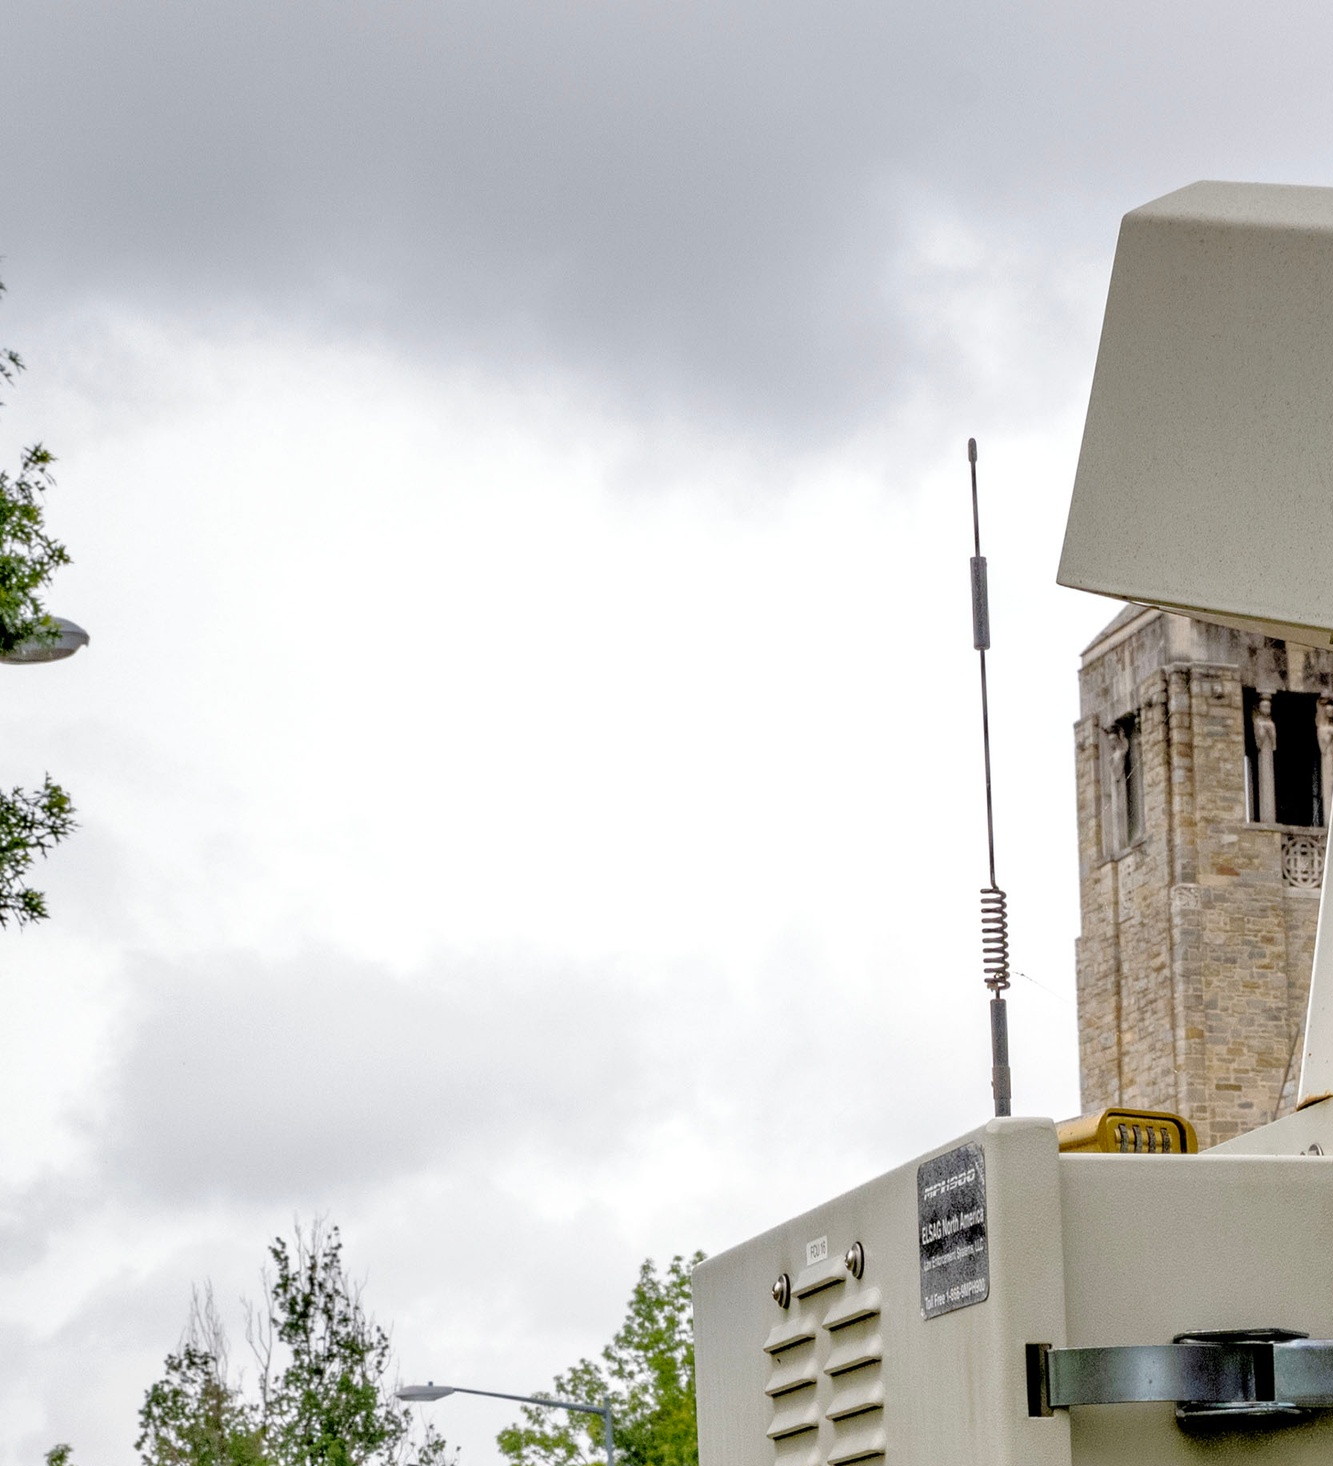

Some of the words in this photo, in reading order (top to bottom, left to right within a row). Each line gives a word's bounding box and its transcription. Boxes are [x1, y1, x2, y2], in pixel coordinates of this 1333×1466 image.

[924, 1168, 975, 1200] MPH900
[922, 1220, 942, 1246] ELSAG
[942, 1213, 959, 1238] North
[959, 1207, 985, 1230] America
[934, 1292, 946, 1307] Free
